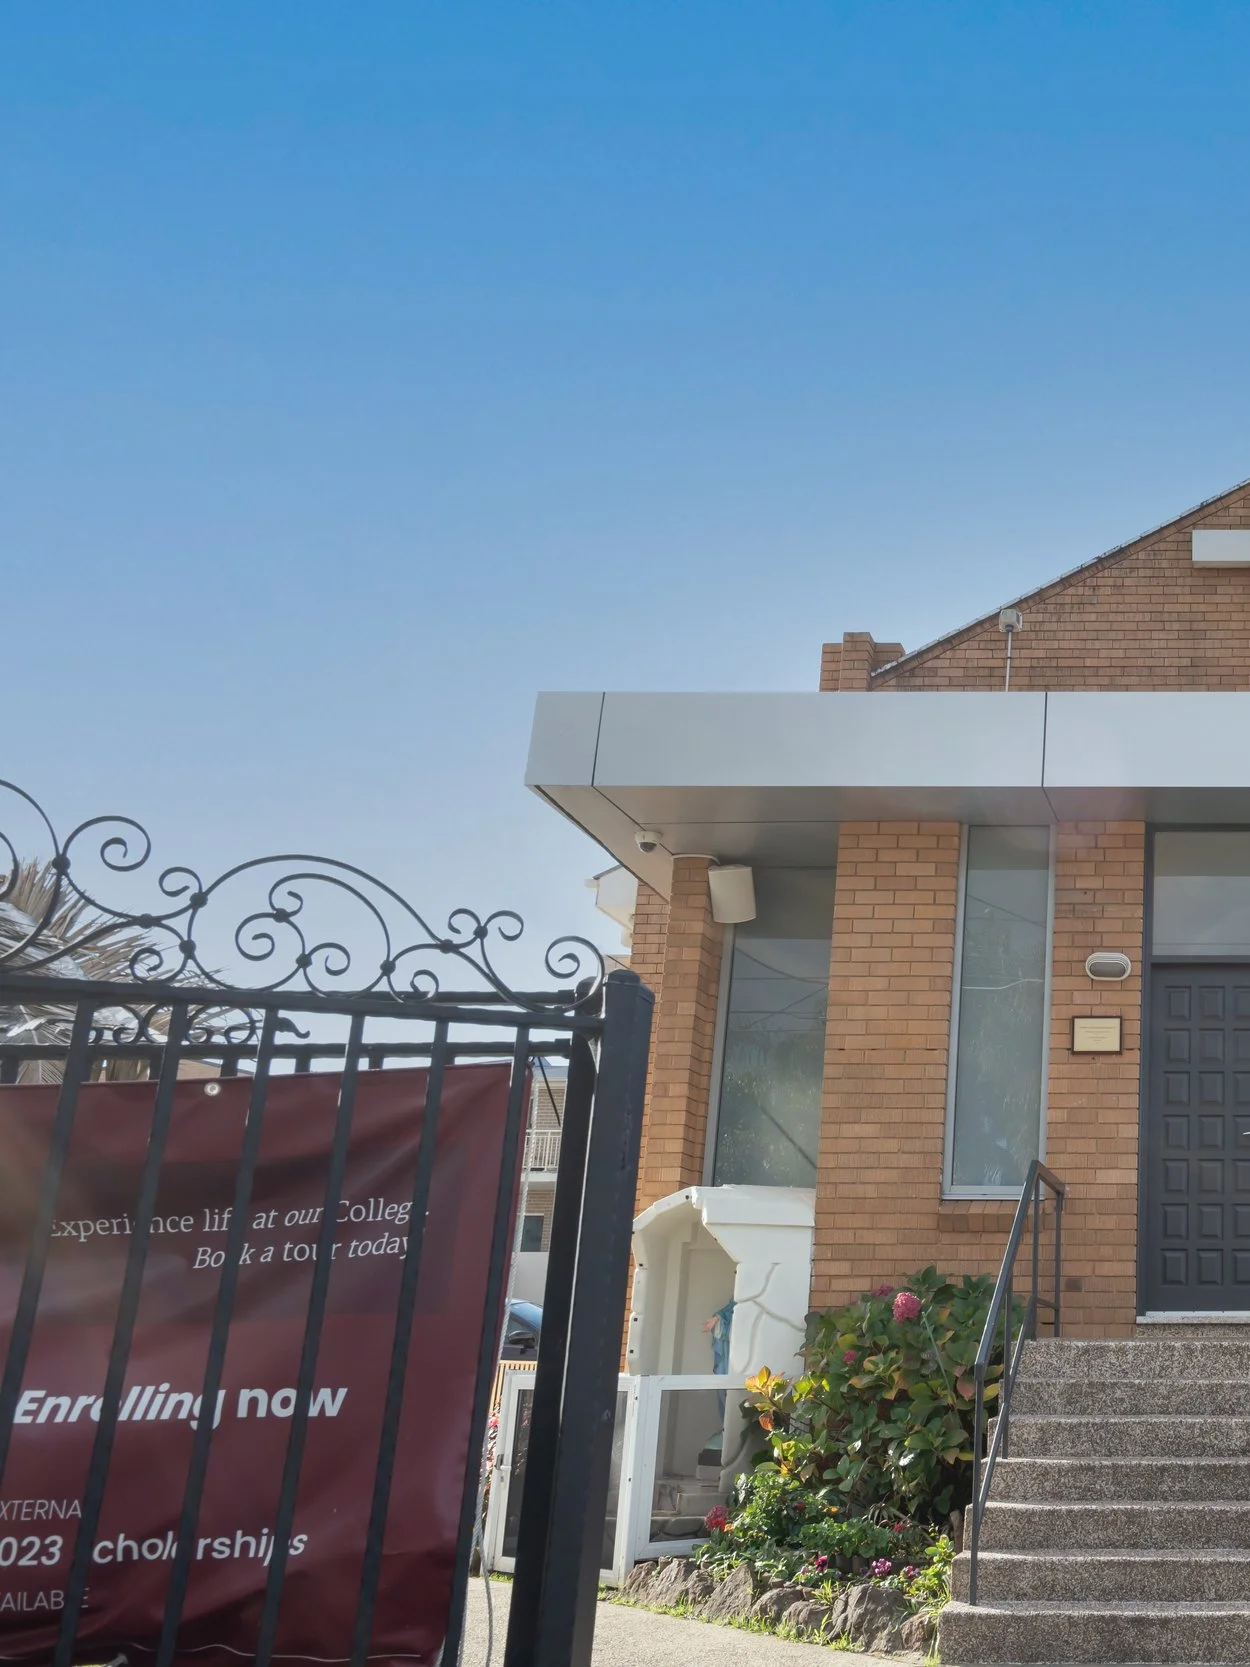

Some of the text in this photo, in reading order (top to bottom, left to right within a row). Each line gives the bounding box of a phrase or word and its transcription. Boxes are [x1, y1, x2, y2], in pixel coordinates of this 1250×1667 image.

[51, 1197, 430, 1242] xperince lif at our Colleg.
[193, 1243, 256, 1269] Bok
[260, 1245, 275, 1263] a
[236, 1387, 348, 1418] now
[92, 1528, 308, 1567] cholrshis
